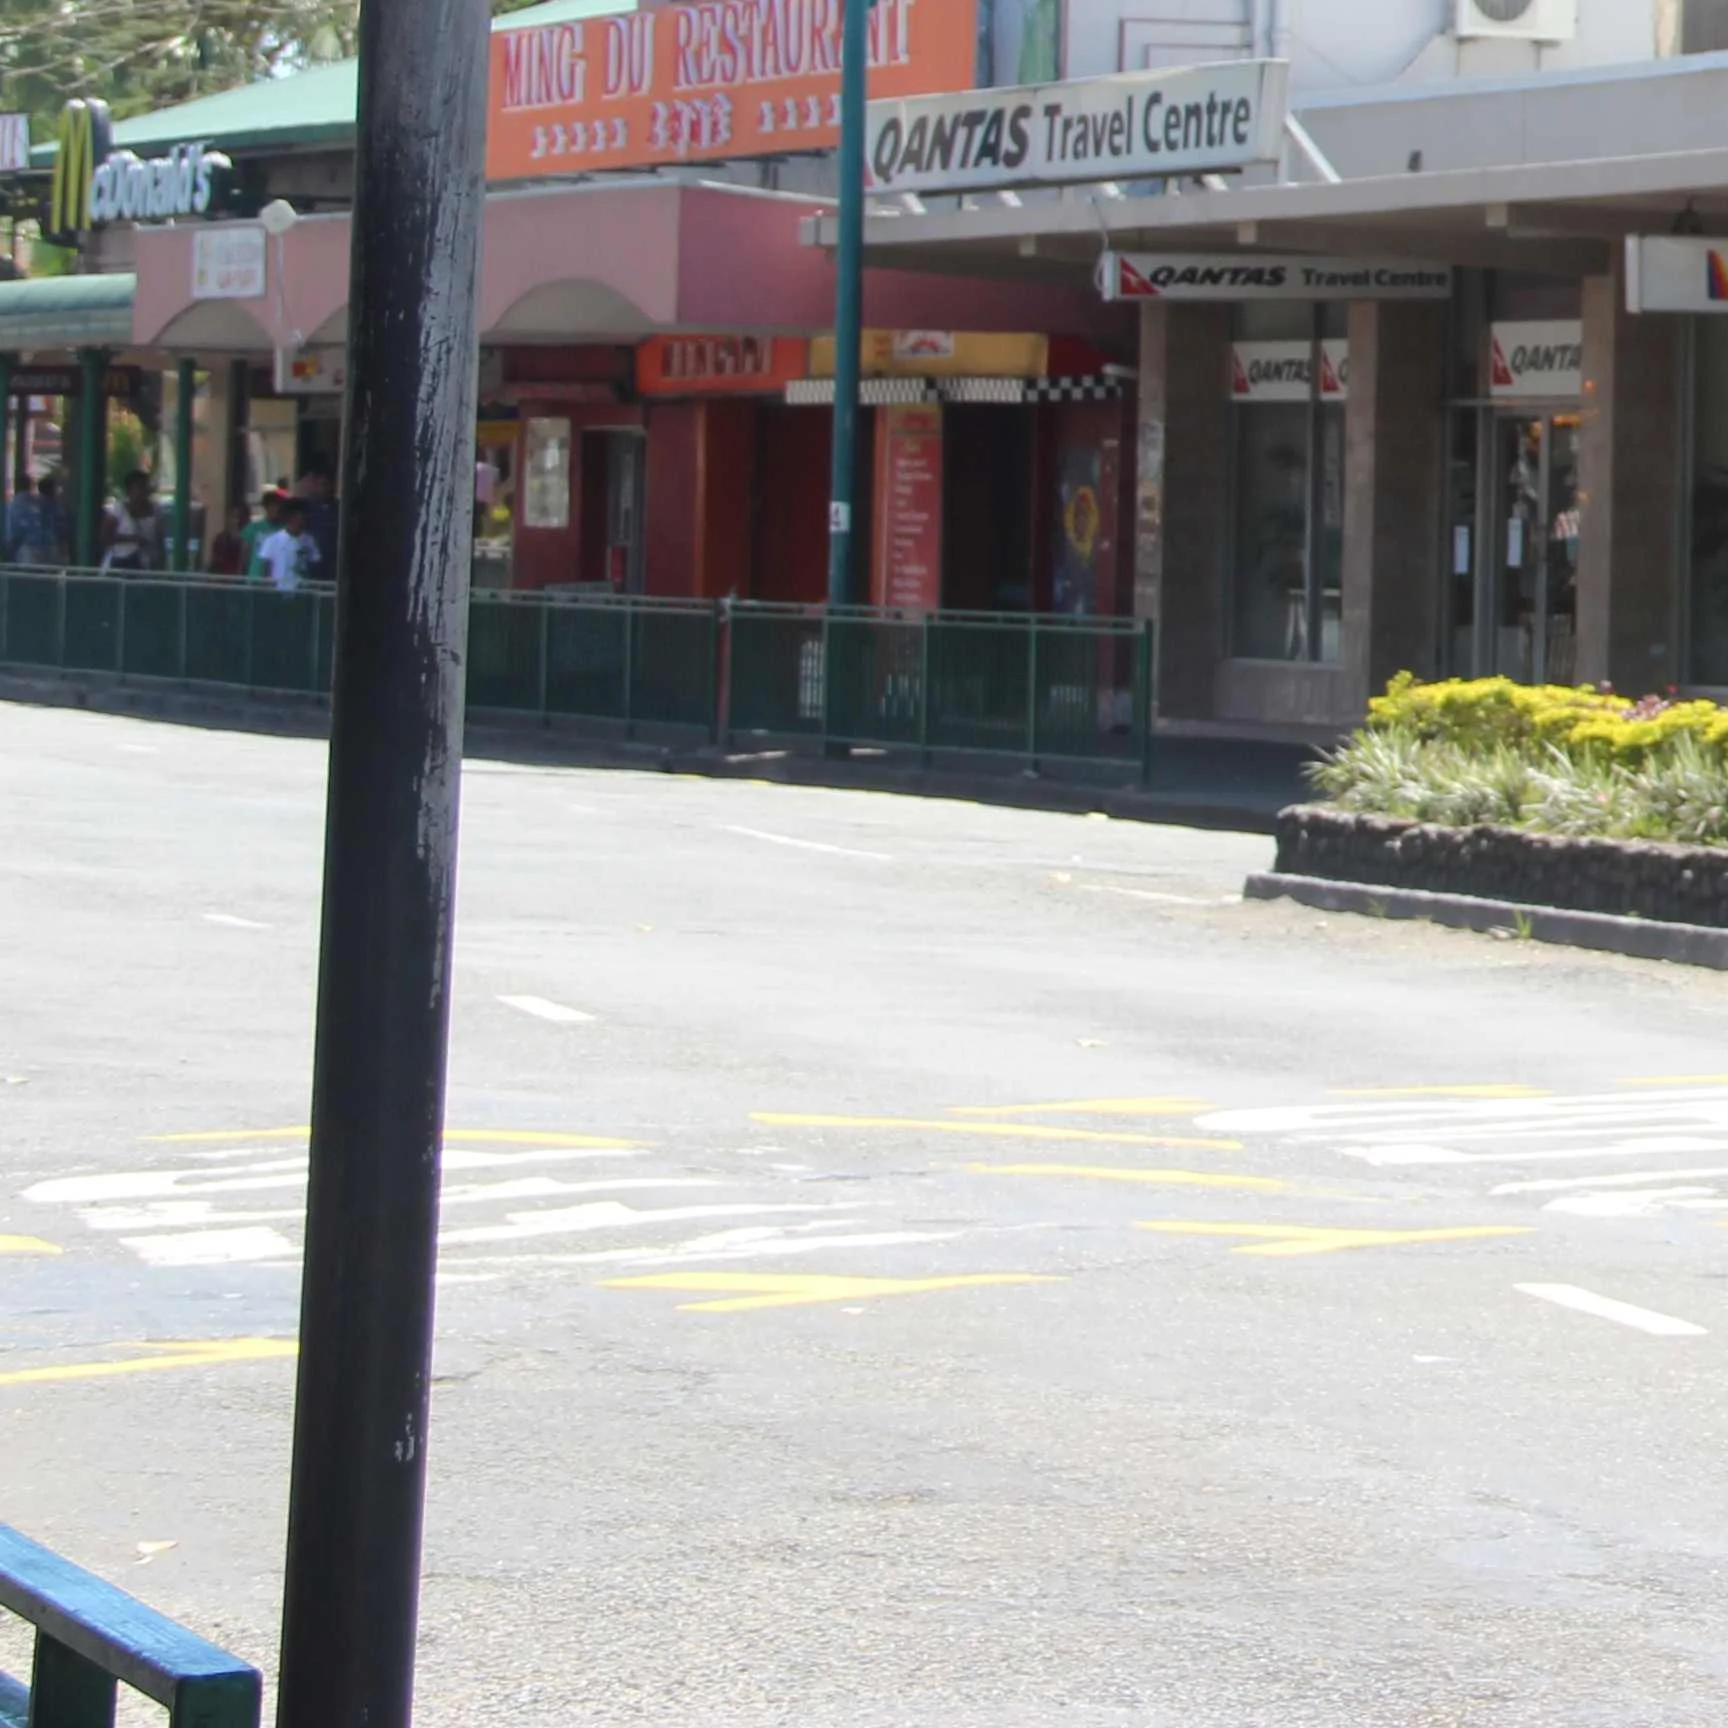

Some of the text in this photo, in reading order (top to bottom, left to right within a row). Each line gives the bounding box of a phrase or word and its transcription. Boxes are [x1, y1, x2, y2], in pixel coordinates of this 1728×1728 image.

[501, 22, 587, 113] MING
[602, 11, 655, 101] DU
[53, 98, 216, 234] McDonald's
[872, 90, 1252, 182] QANTAS Travel Centre
[1149, 265, 1449, 287] QANTAS Travel Centre
[1509, 341, 1582, 378] QANTA
